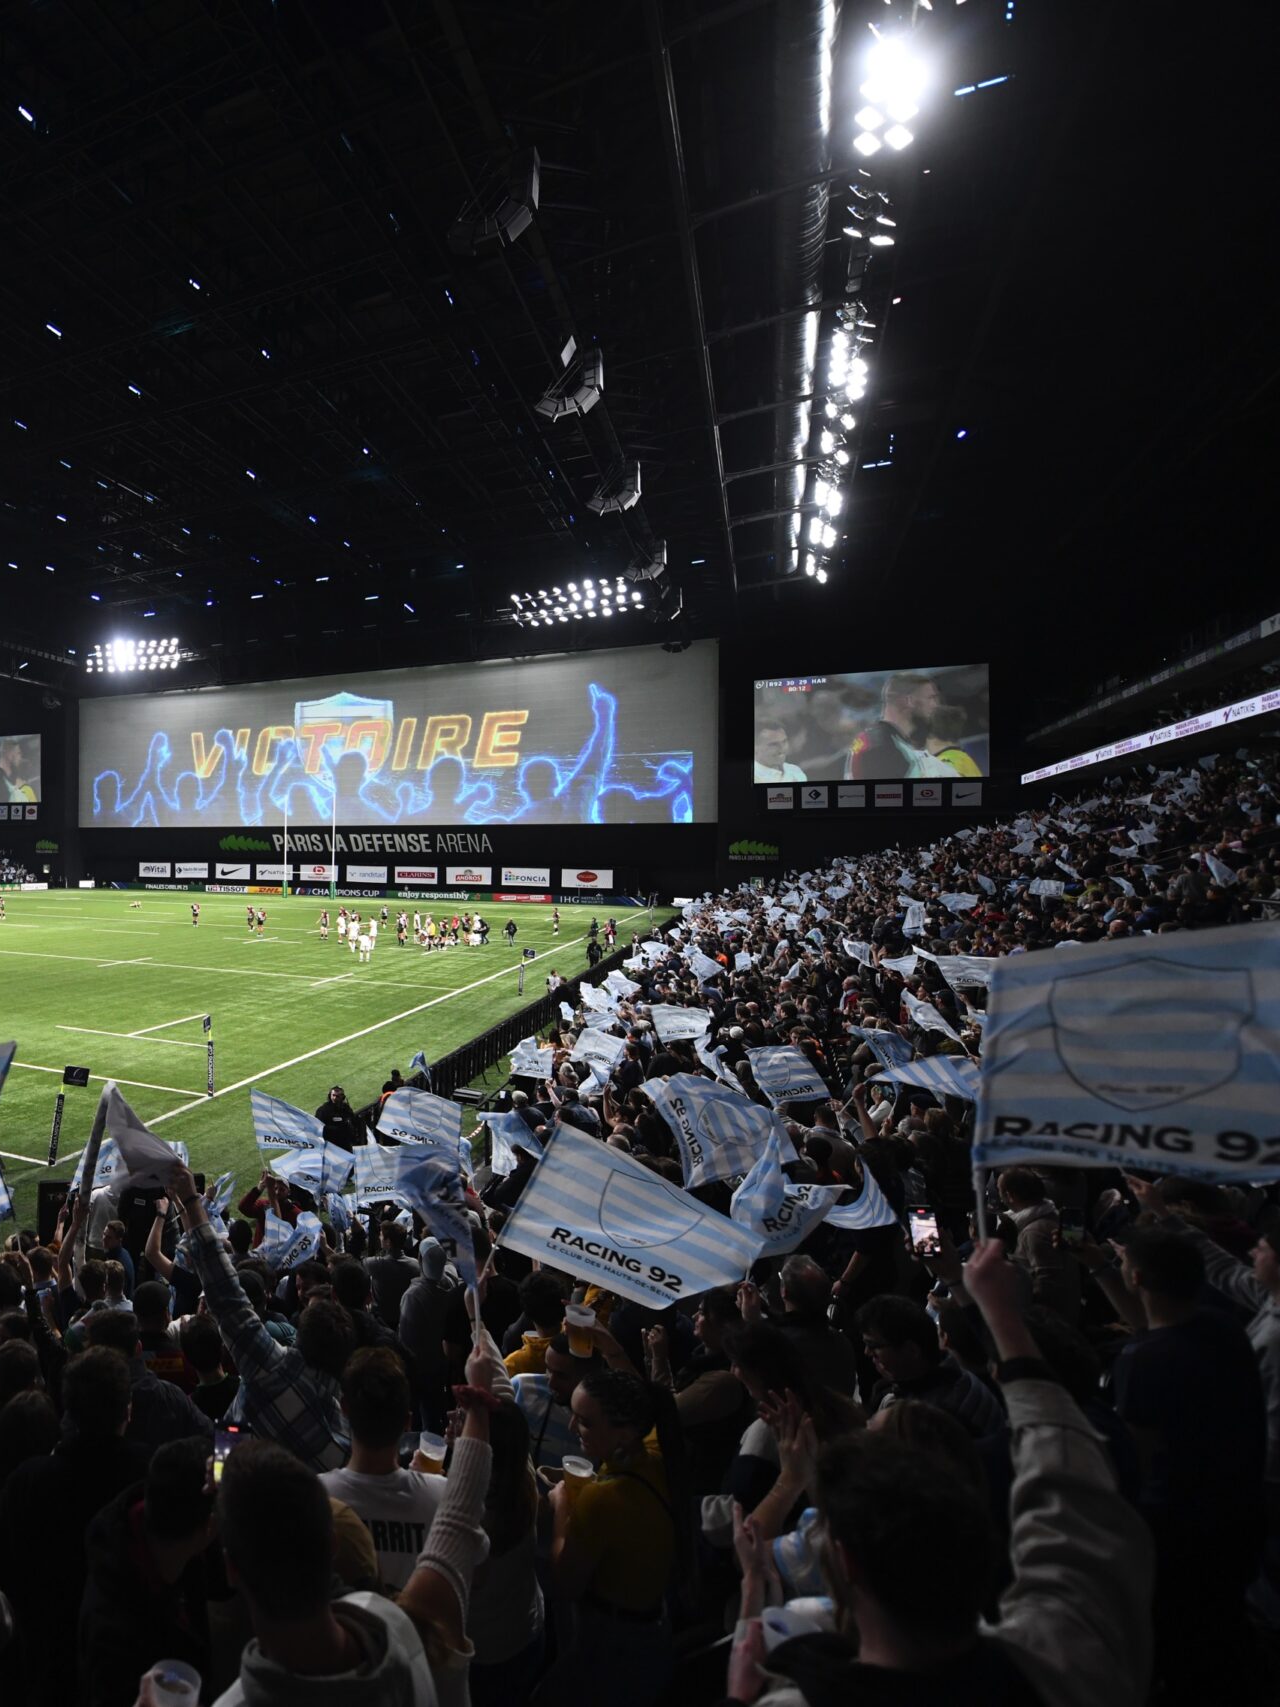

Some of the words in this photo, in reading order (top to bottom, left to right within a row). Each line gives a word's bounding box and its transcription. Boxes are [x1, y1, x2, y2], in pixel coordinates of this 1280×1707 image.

[272, 833, 324, 852] PARIS
[324, 833, 348, 852] LA
[349, 833, 432, 853] DEFENSE
[436, 833, 493, 853] ARENA
[312, 888, 361, 896] CHAPIONS
[362, 889, 380, 897] CUP
[398, 891, 419, 899] enjoy
[421, 892, 469, 901] responsibly
[52, 1113, 62, 1149] CHAMPIONS
[993, 1115, 1195, 1153] RACING
[546, 1242, 557, 1250] LE
[559, 1246, 582, 1261] CLUB
[585, 1257, 601, 1268] DES
[550, 1226, 642, 1274] RACING
[647, 1266, 683, 1293] 92
